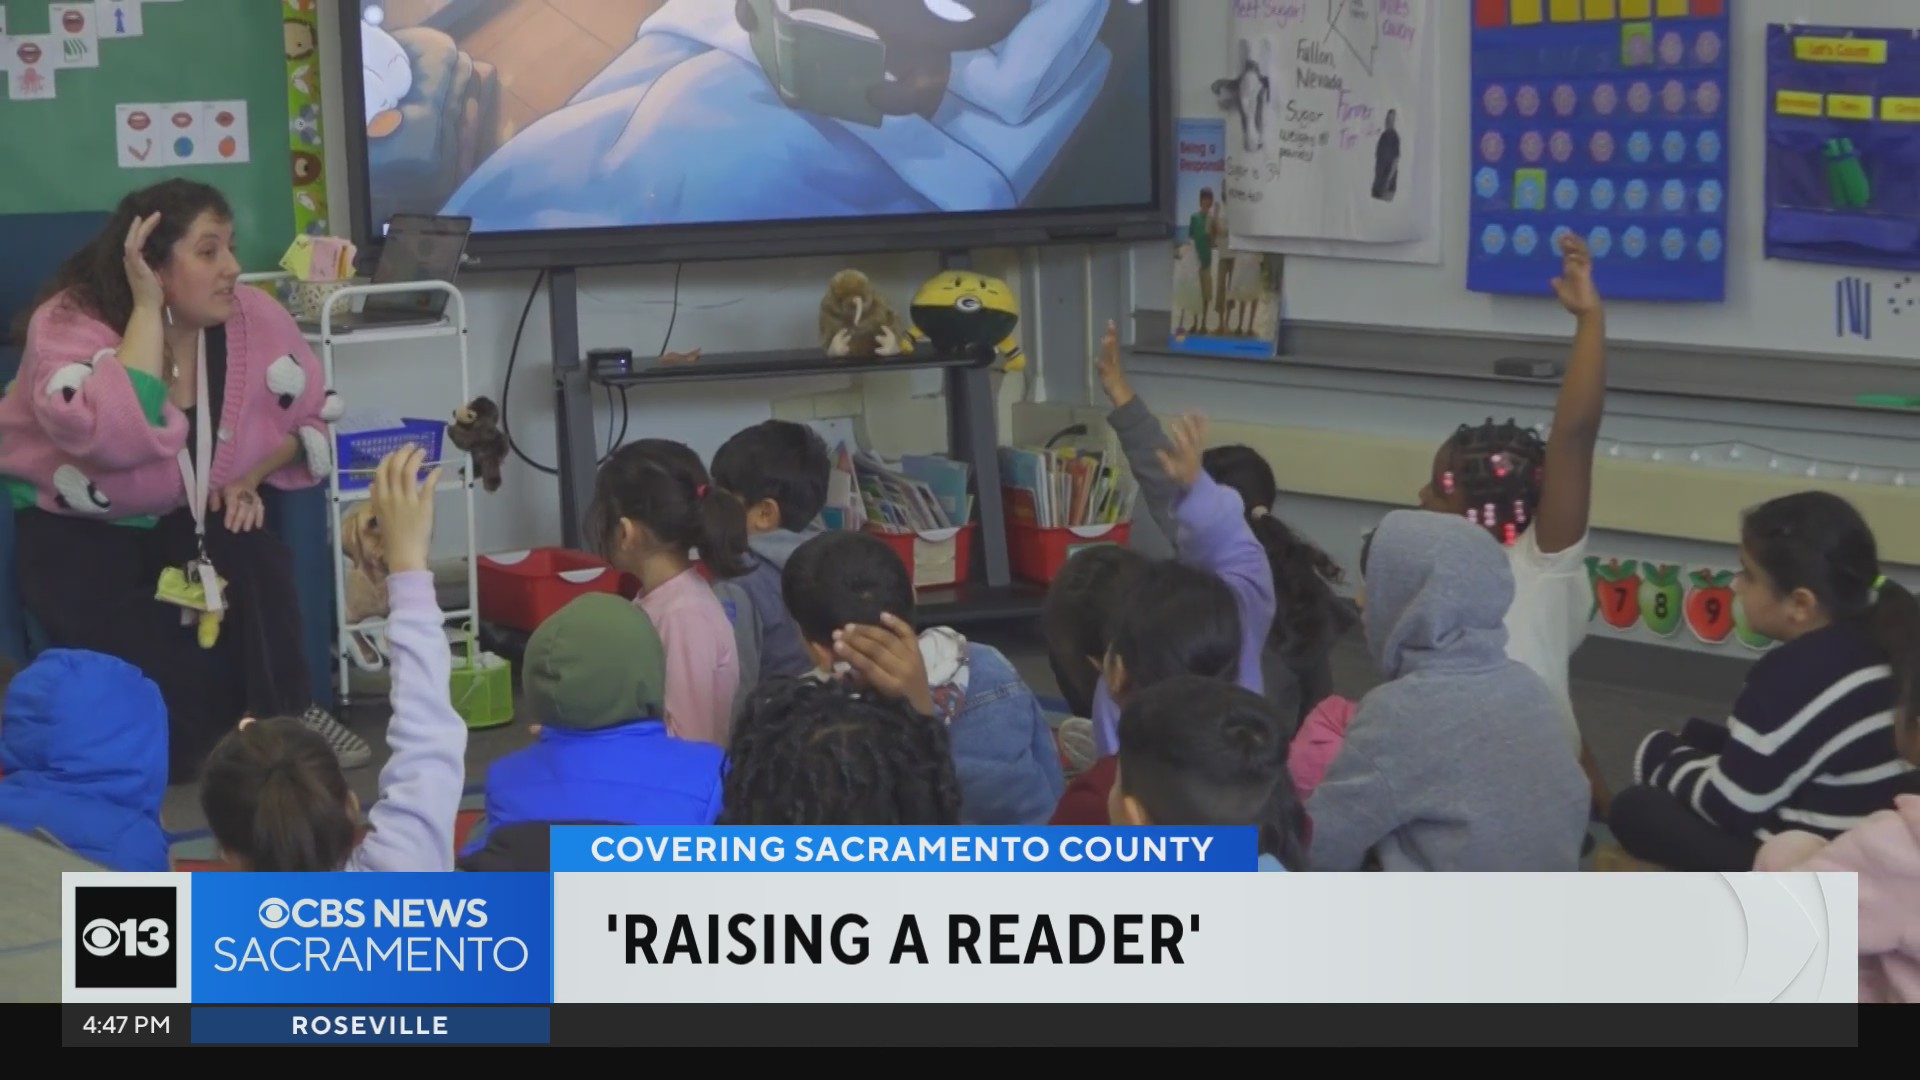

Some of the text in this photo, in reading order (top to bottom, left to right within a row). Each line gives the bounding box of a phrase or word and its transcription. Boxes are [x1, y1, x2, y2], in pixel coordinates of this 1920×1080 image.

[1296, 38, 1336, 69] Fallon,
[1285, 100, 1324, 128] Sugar
[1614, 587, 1627, 613] 7
[1654, 592, 1668, 619] 8
[1705, 596, 1721, 624] 9
